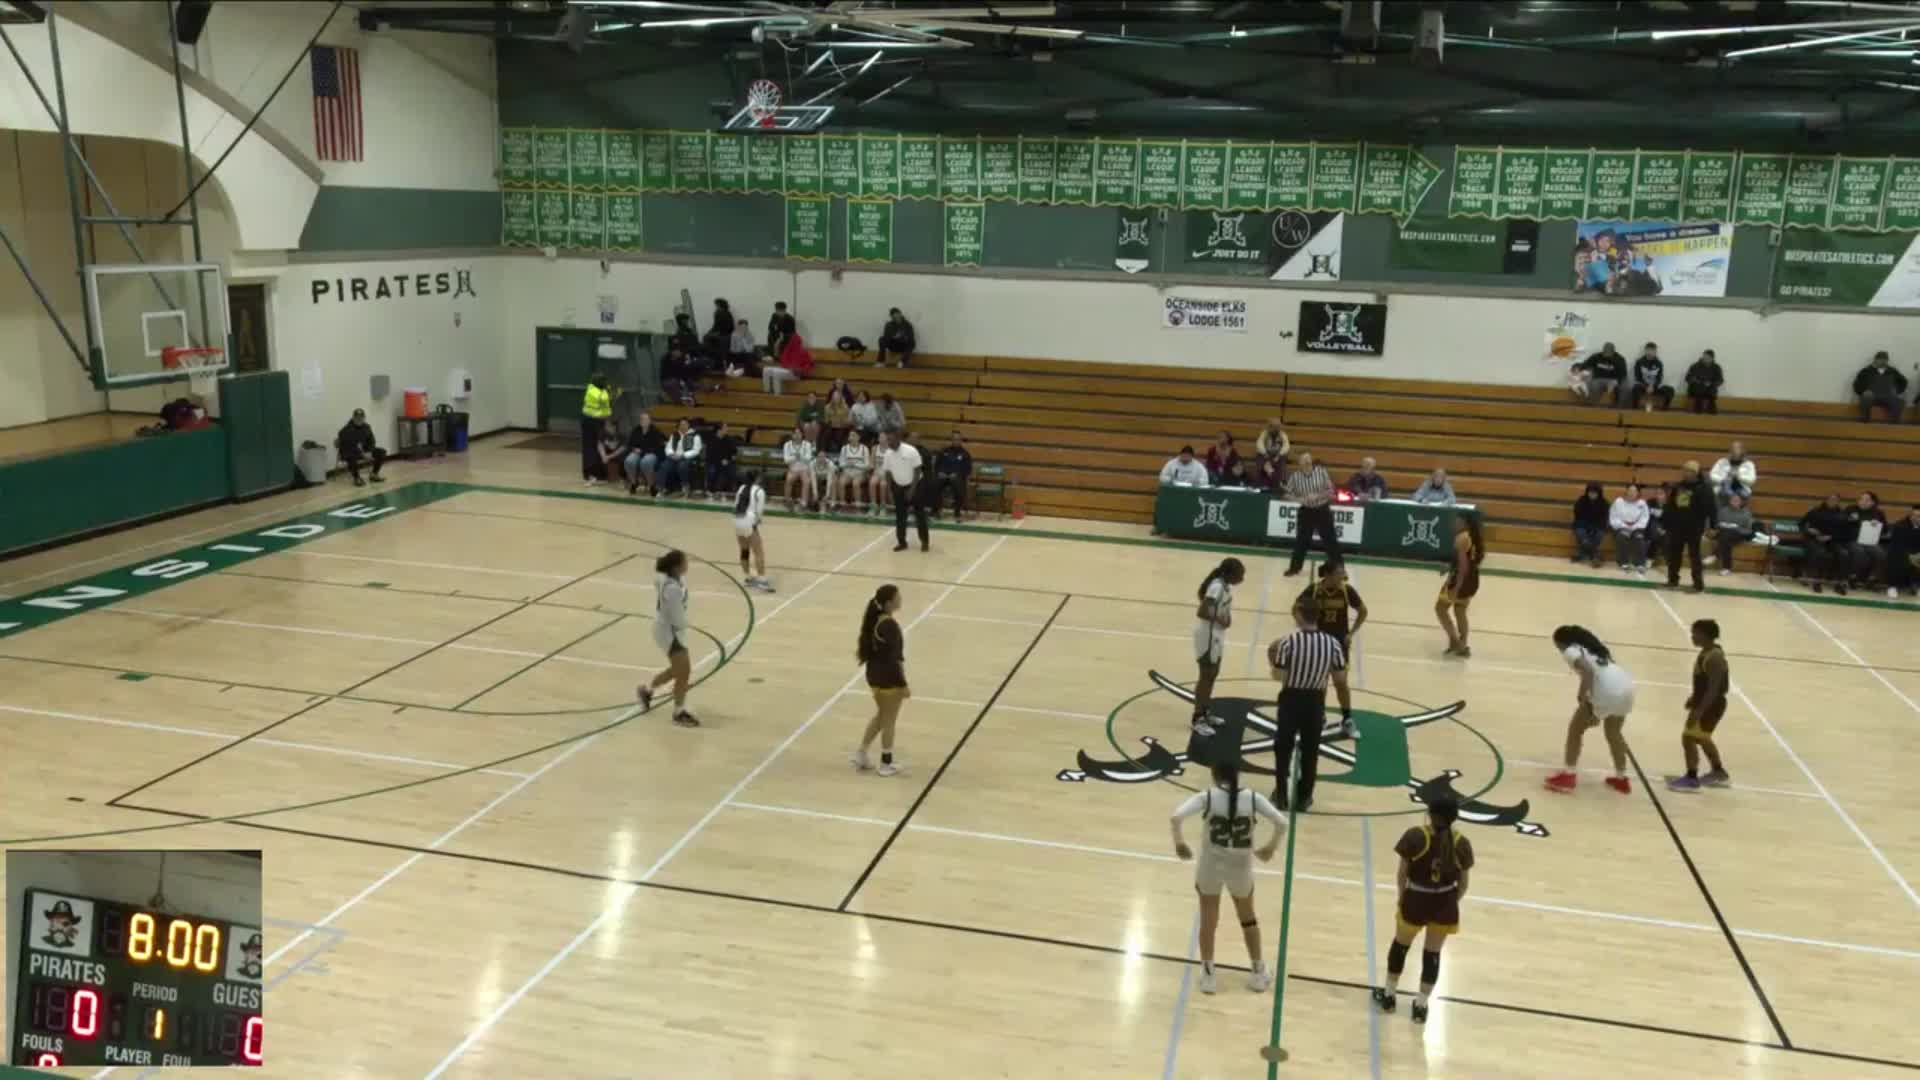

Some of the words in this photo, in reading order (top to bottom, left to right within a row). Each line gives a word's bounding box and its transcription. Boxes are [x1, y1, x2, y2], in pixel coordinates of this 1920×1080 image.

[312, 272, 450, 304] PIRATES
[1780, 286, 1792, 296] GO
[1166, 297, 1220, 312] OCEANSIDE
[1221, 301, 1247, 313] ELKS
[1189, 315, 1221, 327] LODGE
[1306, 340, 1375, 352] VOLLEYBALL
[1209, 815, 1253, 849] 22
[29, 954, 106, 986] PIRATES
[132, 982, 178, 1002] PERIOD
[213, 983, 262, 1009] GUES
[72, 990, 98, 1036] 0
[153, 1008, 165, 1040] 1
[22, 1033, 64, 1053] FOULS
[105, 1045, 152, 1065] PLAYER
